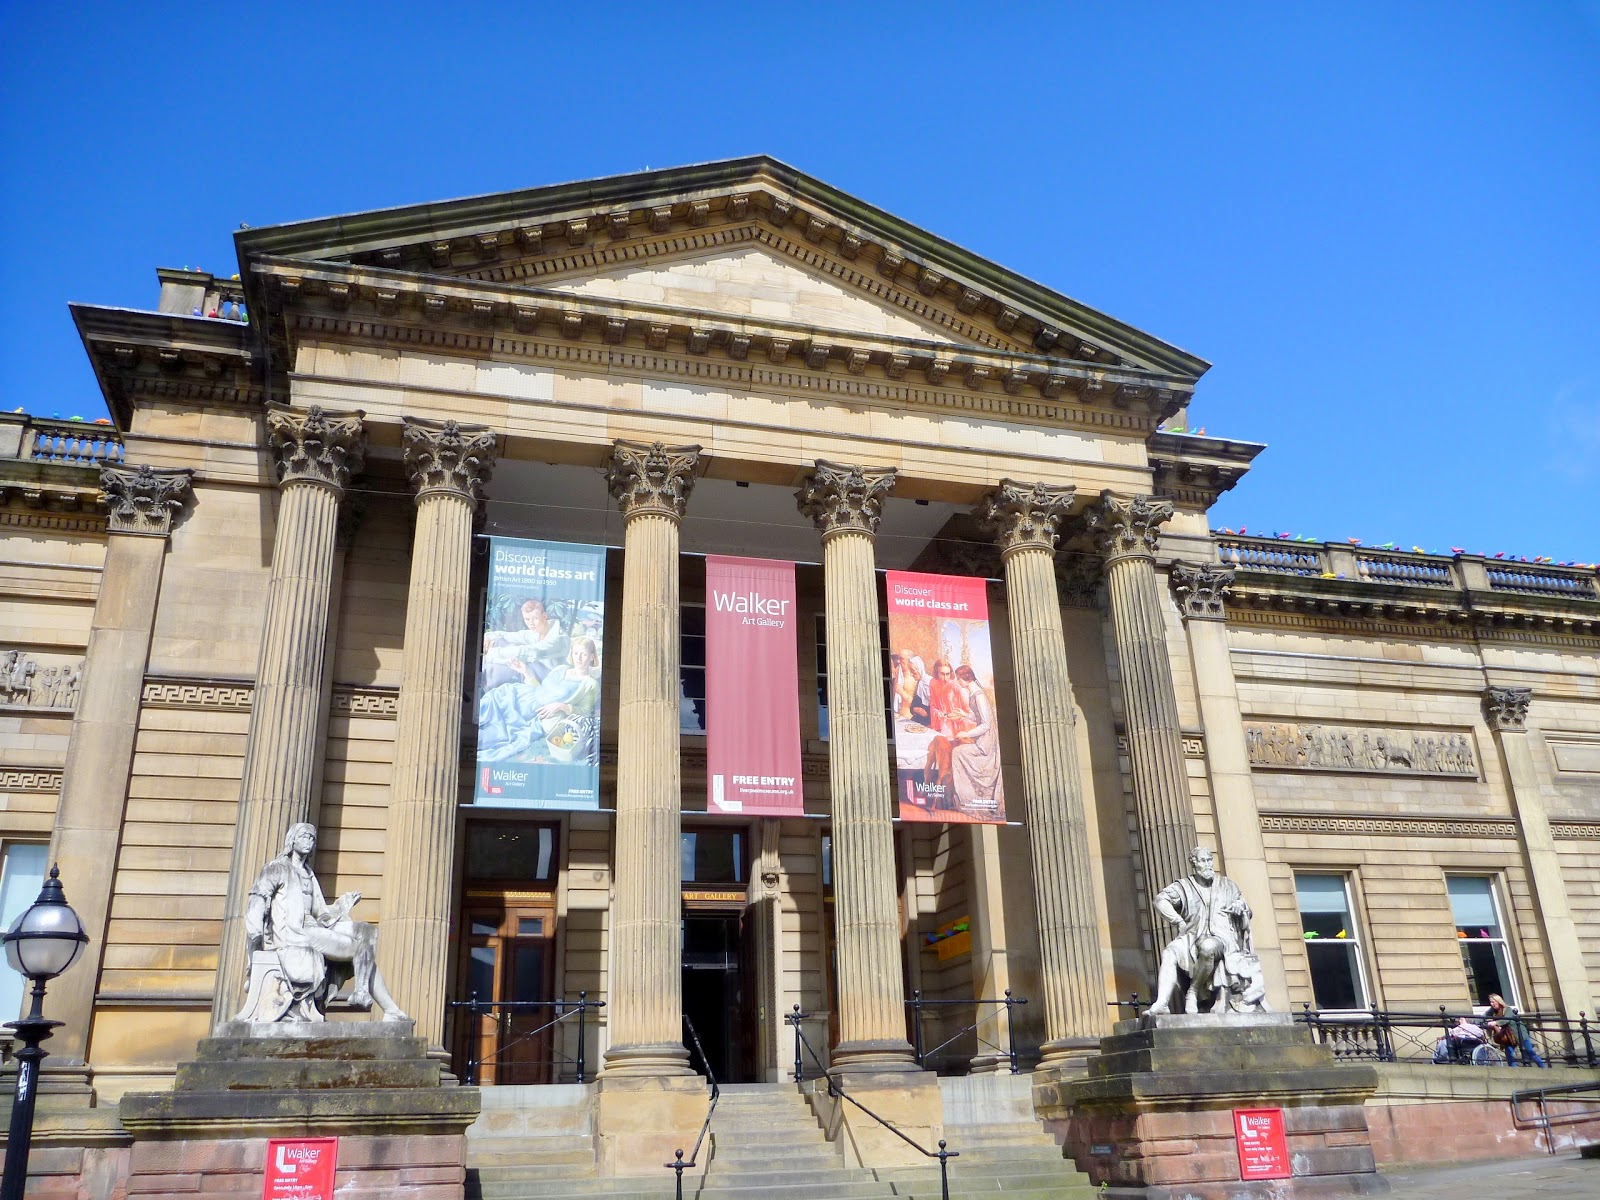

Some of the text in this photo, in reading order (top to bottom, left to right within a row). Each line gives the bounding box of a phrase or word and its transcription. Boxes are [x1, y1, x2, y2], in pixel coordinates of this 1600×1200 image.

[495, 550, 547, 565] Discover
[494, 565, 595, 580] world class art
[894, 584, 932, 596] Discover
[714, 590, 790, 616] Walker
[895, 598, 968, 611] world class art
[742, 617, 784, 628] Art Gallery
[492, 770, 528, 781] Walker
[733, 776, 795, 786] FREE ENTRY
[915, 782, 946, 793] Walker
[1247, 1116, 1270, 1125] Walker
[287, 1148, 321, 1159] Walker
